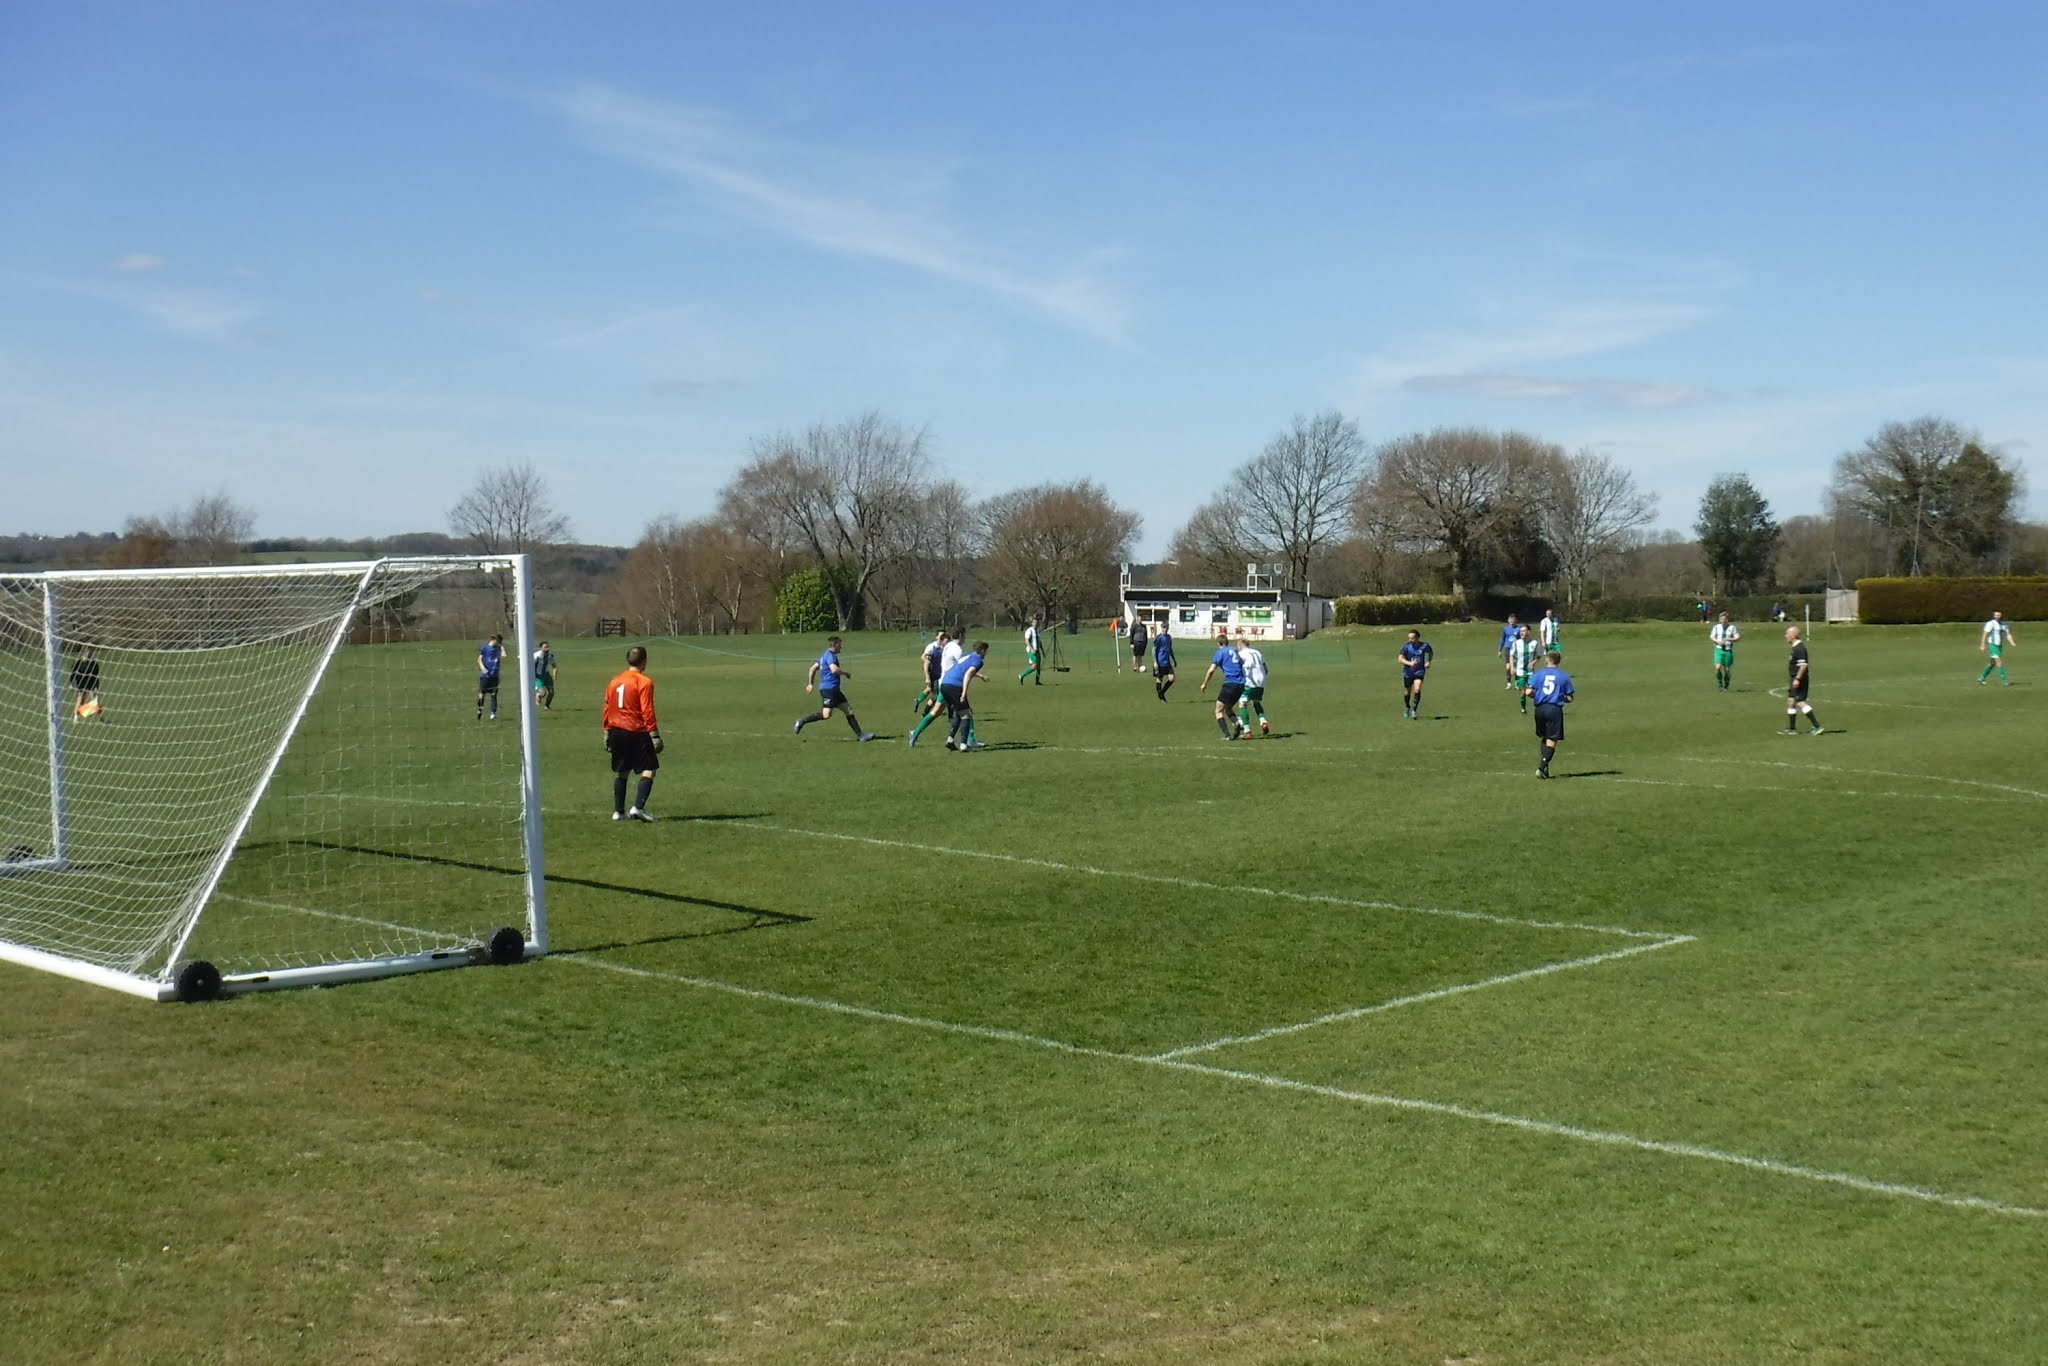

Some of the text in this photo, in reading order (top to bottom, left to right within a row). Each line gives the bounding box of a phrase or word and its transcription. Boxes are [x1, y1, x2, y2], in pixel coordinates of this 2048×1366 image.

[1229, 649, 1239, 664] 2
[1543, 675, 1556, 695] 5
[616, 684, 625, 709] 1
